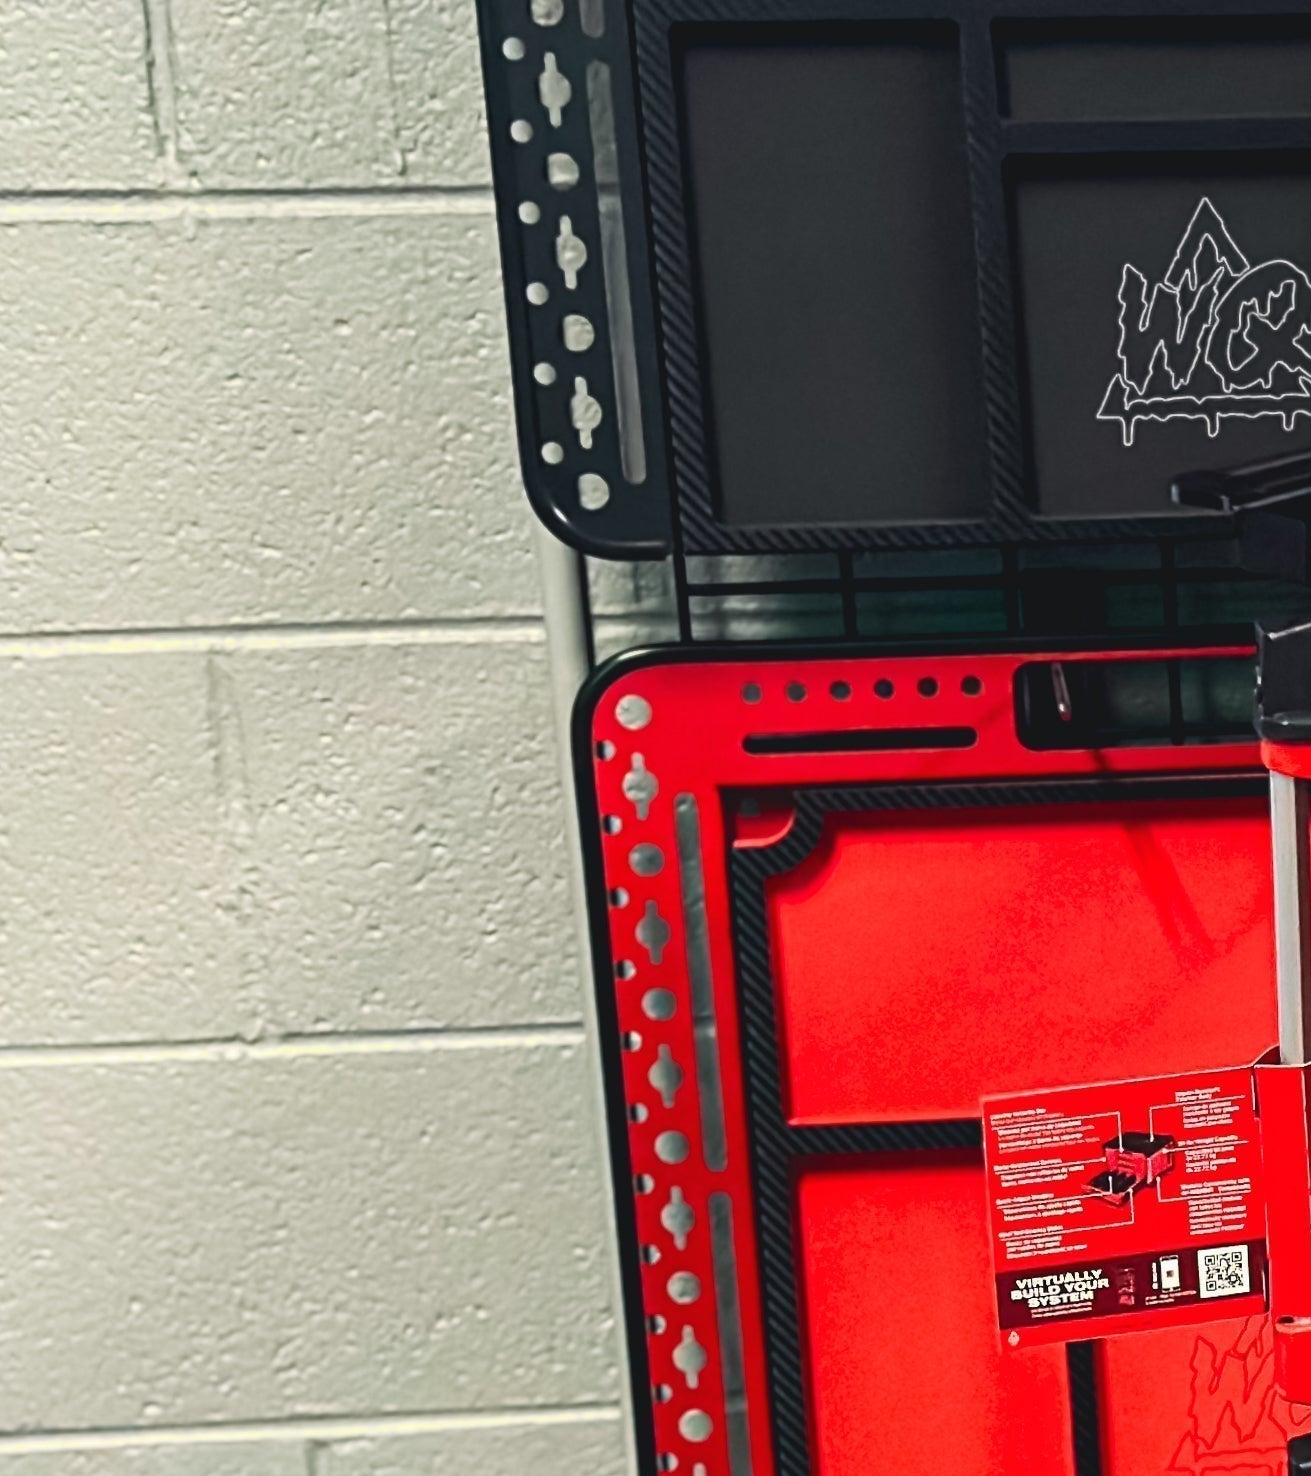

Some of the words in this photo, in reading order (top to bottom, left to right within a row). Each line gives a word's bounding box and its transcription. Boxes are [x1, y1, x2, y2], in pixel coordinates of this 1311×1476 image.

[1015, 1268, 1103, 1289] VIRTUALLY
[1010, 1285, 1061, 1301] BUILD
[1064, 1278, 1110, 1293] YOUR
[1027, 1290, 1094, 1308] SYSTEM
